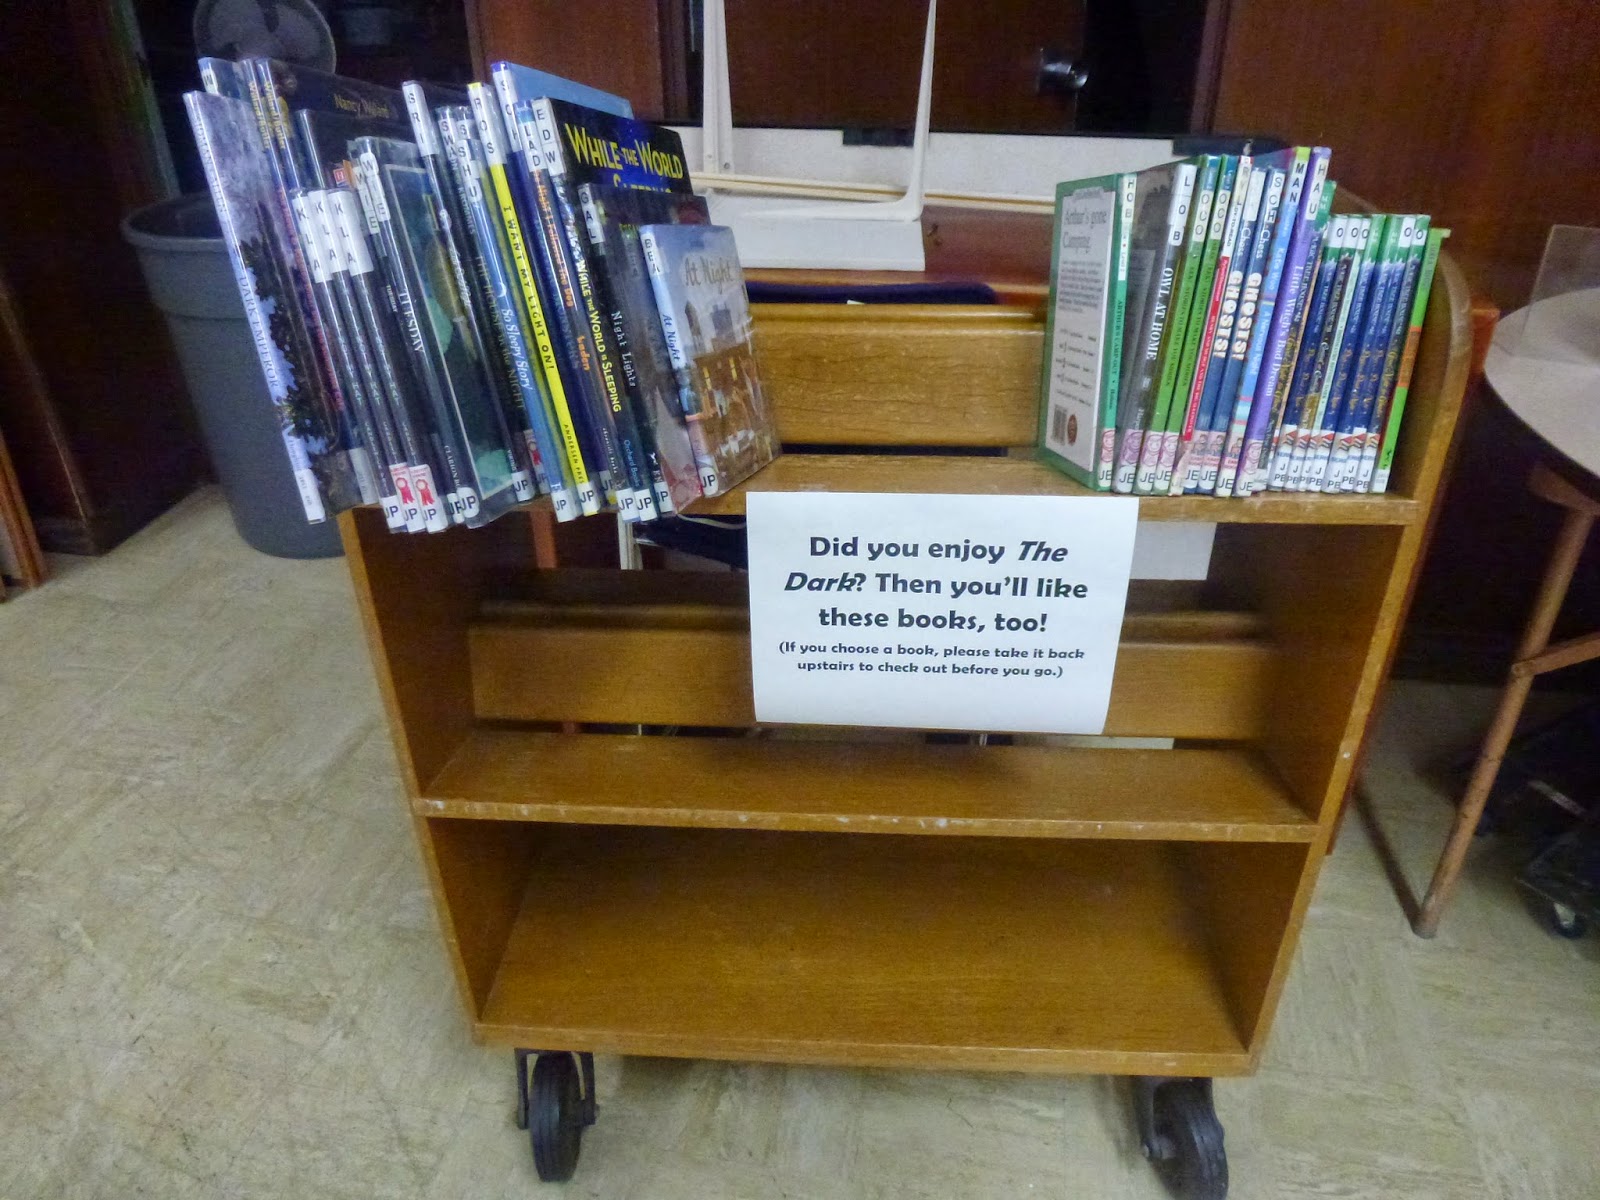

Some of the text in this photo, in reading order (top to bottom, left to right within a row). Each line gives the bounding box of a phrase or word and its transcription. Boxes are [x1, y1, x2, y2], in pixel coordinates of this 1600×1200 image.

[408, 92, 423, 144] SRI
[474, 98, 494, 154] ROS
[441, 120, 457, 157] SWA
[524, 125, 541, 166] LAD
[536, 109, 556, 164] EDW
[565, 123, 684, 179] WHILE THE WORLD
[1124, 179, 1135, 218] HOB
[1267, 176, 1283, 222] SCH
[1290, 163, 1305, 203] MAN
[1309, 165, 1327, 214] HAU
[580, 192, 597, 239] GAL
[1172, 175, 1190, 241] LOB
[1194, 193, 1210, 236] OCO
[1213, 193, 1228, 235] OCO
[297, 208, 321, 271] KLA
[315, 201, 337, 260] KLA
[334, 203, 356, 263] KLA
[548, 221, 564, 264] Followed
[1235, 226, 1251, 257] Chess
[1255, 228, 1271, 260] Chess
[559, 266, 571, 286] The
[575, 259, 594, 297] WHILE
[685, 257, 701, 286] At
[1268, 246, 1285, 290] Katie Woo
[508, 218, 525, 261] WANT
[522, 267, 533, 289] MY
[528, 295, 545, 337] LIGHT
[541, 343, 554, 370] ON!
[563, 286, 575, 307] Dog
[587, 297, 596, 311] THE
[240, 275, 279, 388] DARK EMPEROR
[399, 288, 425, 354] TUESDAY
[589, 309, 609, 353] WORLD
[1145, 266, 1173, 361] OWL AT HOME
[1212, 268, 1244, 359] GHOSTS!
[1230, 270, 1263, 360] GHOSTS!
[1265, 265, 1302, 396] Little Witch's Bad Dream
[502, 306, 535, 392] So Sleepy Story
[611, 309, 640, 387] Night Lights
[663, 312, 683, 362] At Night
[1254, 318, 1268, 350] Nervous
[577, 335, 592, 371] Laden
[1248, 351, 1261, 374] Night
[601, 360, 624, 412] SLEEPING
[444, 444, 458, 477] CLARION
[508, 450, 516, 471] VIKING
[563, 423, 585, 484] ANDERSEN PRES
[623, 438, 643, 487] Orchard Books
[514, 479, 528, 492] JP
[702, 474, 716, 488] JP
[1099, 470, 1112, 481] JE
[1119, 472, 1135, 483] JE
[1156, 470, 1171, 481] JE
[1185, 469, 1200, 480] JE
[1200, 470, 1217, 481] JE
[1216, 478, 1234, 489] JE
[1240, 481, 1253, 491] JE
[384, 505, 398, 518] JP
[404, 508, 418, 521] JP
[423, 508, 436, 521] JP
[461, 496, 476, 511] JP
[556, 500, 567, 511] JP
[581, 490, 594, 503] JP
[620, 498, 633, 511] JP
[637, 497, 651, 511] JP
[655, 490, 668, 503] JP
[811, 537, 1069, 564] Did you enjoy The
[784, 572, 1088, 599] Dark? Then you'll like
[818, 607, 1048, 633] these books, too!
[778, 641, 1085, 659] (If you choose a book, please take it back
[797, 661, 1064, 678] upstairs to check out before you go.)
